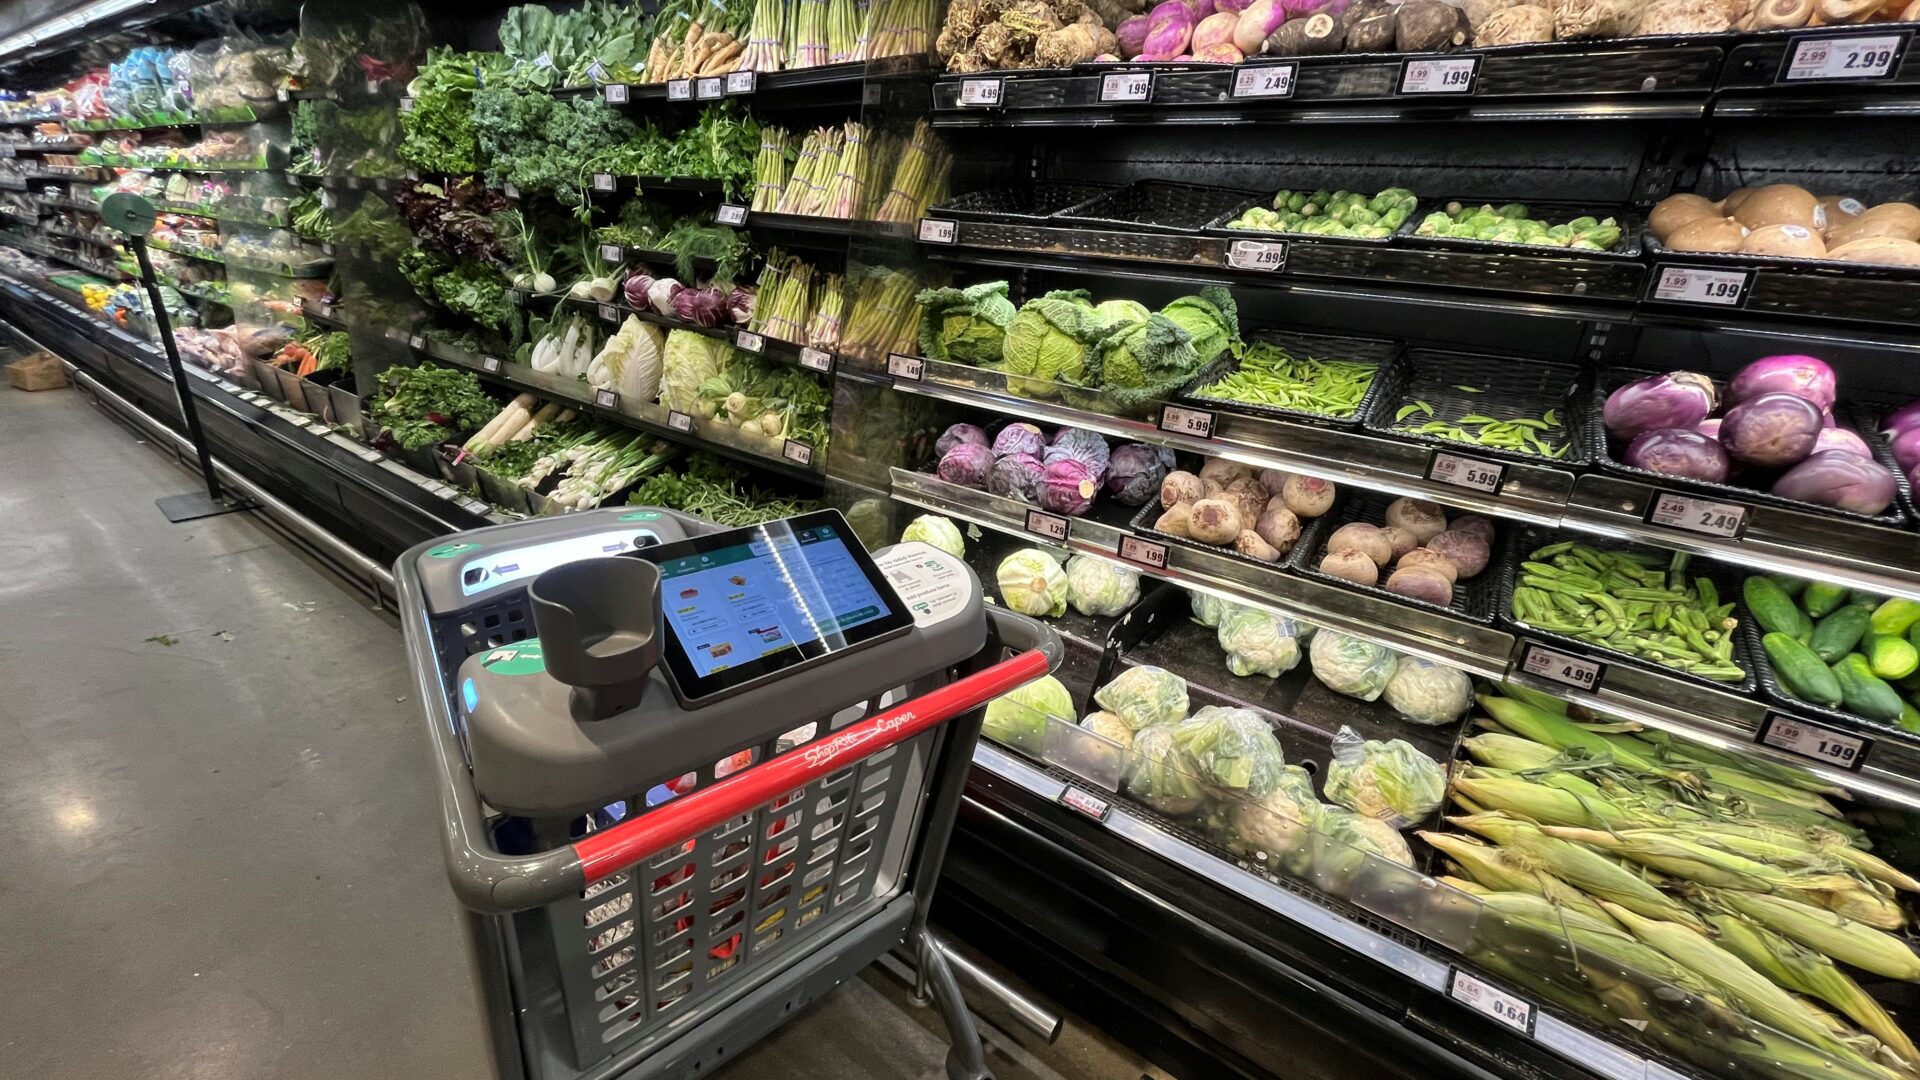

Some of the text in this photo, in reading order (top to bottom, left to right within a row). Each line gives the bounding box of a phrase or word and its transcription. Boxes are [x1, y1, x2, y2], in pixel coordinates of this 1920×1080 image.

[1798, 51, 1827, 61] 2.99
[1844, 51, 1891, 68] 2.99
[1264, 77, 1288, 90] 2.49
[1442, 71, 1469, 85] 1.99
[981, 88, 998, 99] 4.99
[1128, 83, 1147, 95] 1.99
[939, 229, 952, 239] 1.99
[1256, 252, 1279, 264] 2.99
[1665, 277, 1687, 286] 1.99
[1705, 282, 1739, 298] 1.99
[1187, 419, 1209, 432] 5.99
[1466, 470, 1497, 486] 5.99
[1661, 502, 1684, 513] 2.49
[1700, 512, 1738, 530] 2.49
[1050, 524, 1064, 535] 1.29
[1146, 550, 1163, 563] 1.99
[1531, 654, 1550, 665] 4.99
[1562, 666, 1594, 684] 4.99
[1775, 725, 1799, 738] 1.99
[804, 732, 857, 768] ShopRite
[1818, 741, 1855, 761] 1.99
[1458, 980, 1479, 995] 0.64
[1493, 1000, 1526, 1025] 0.64
